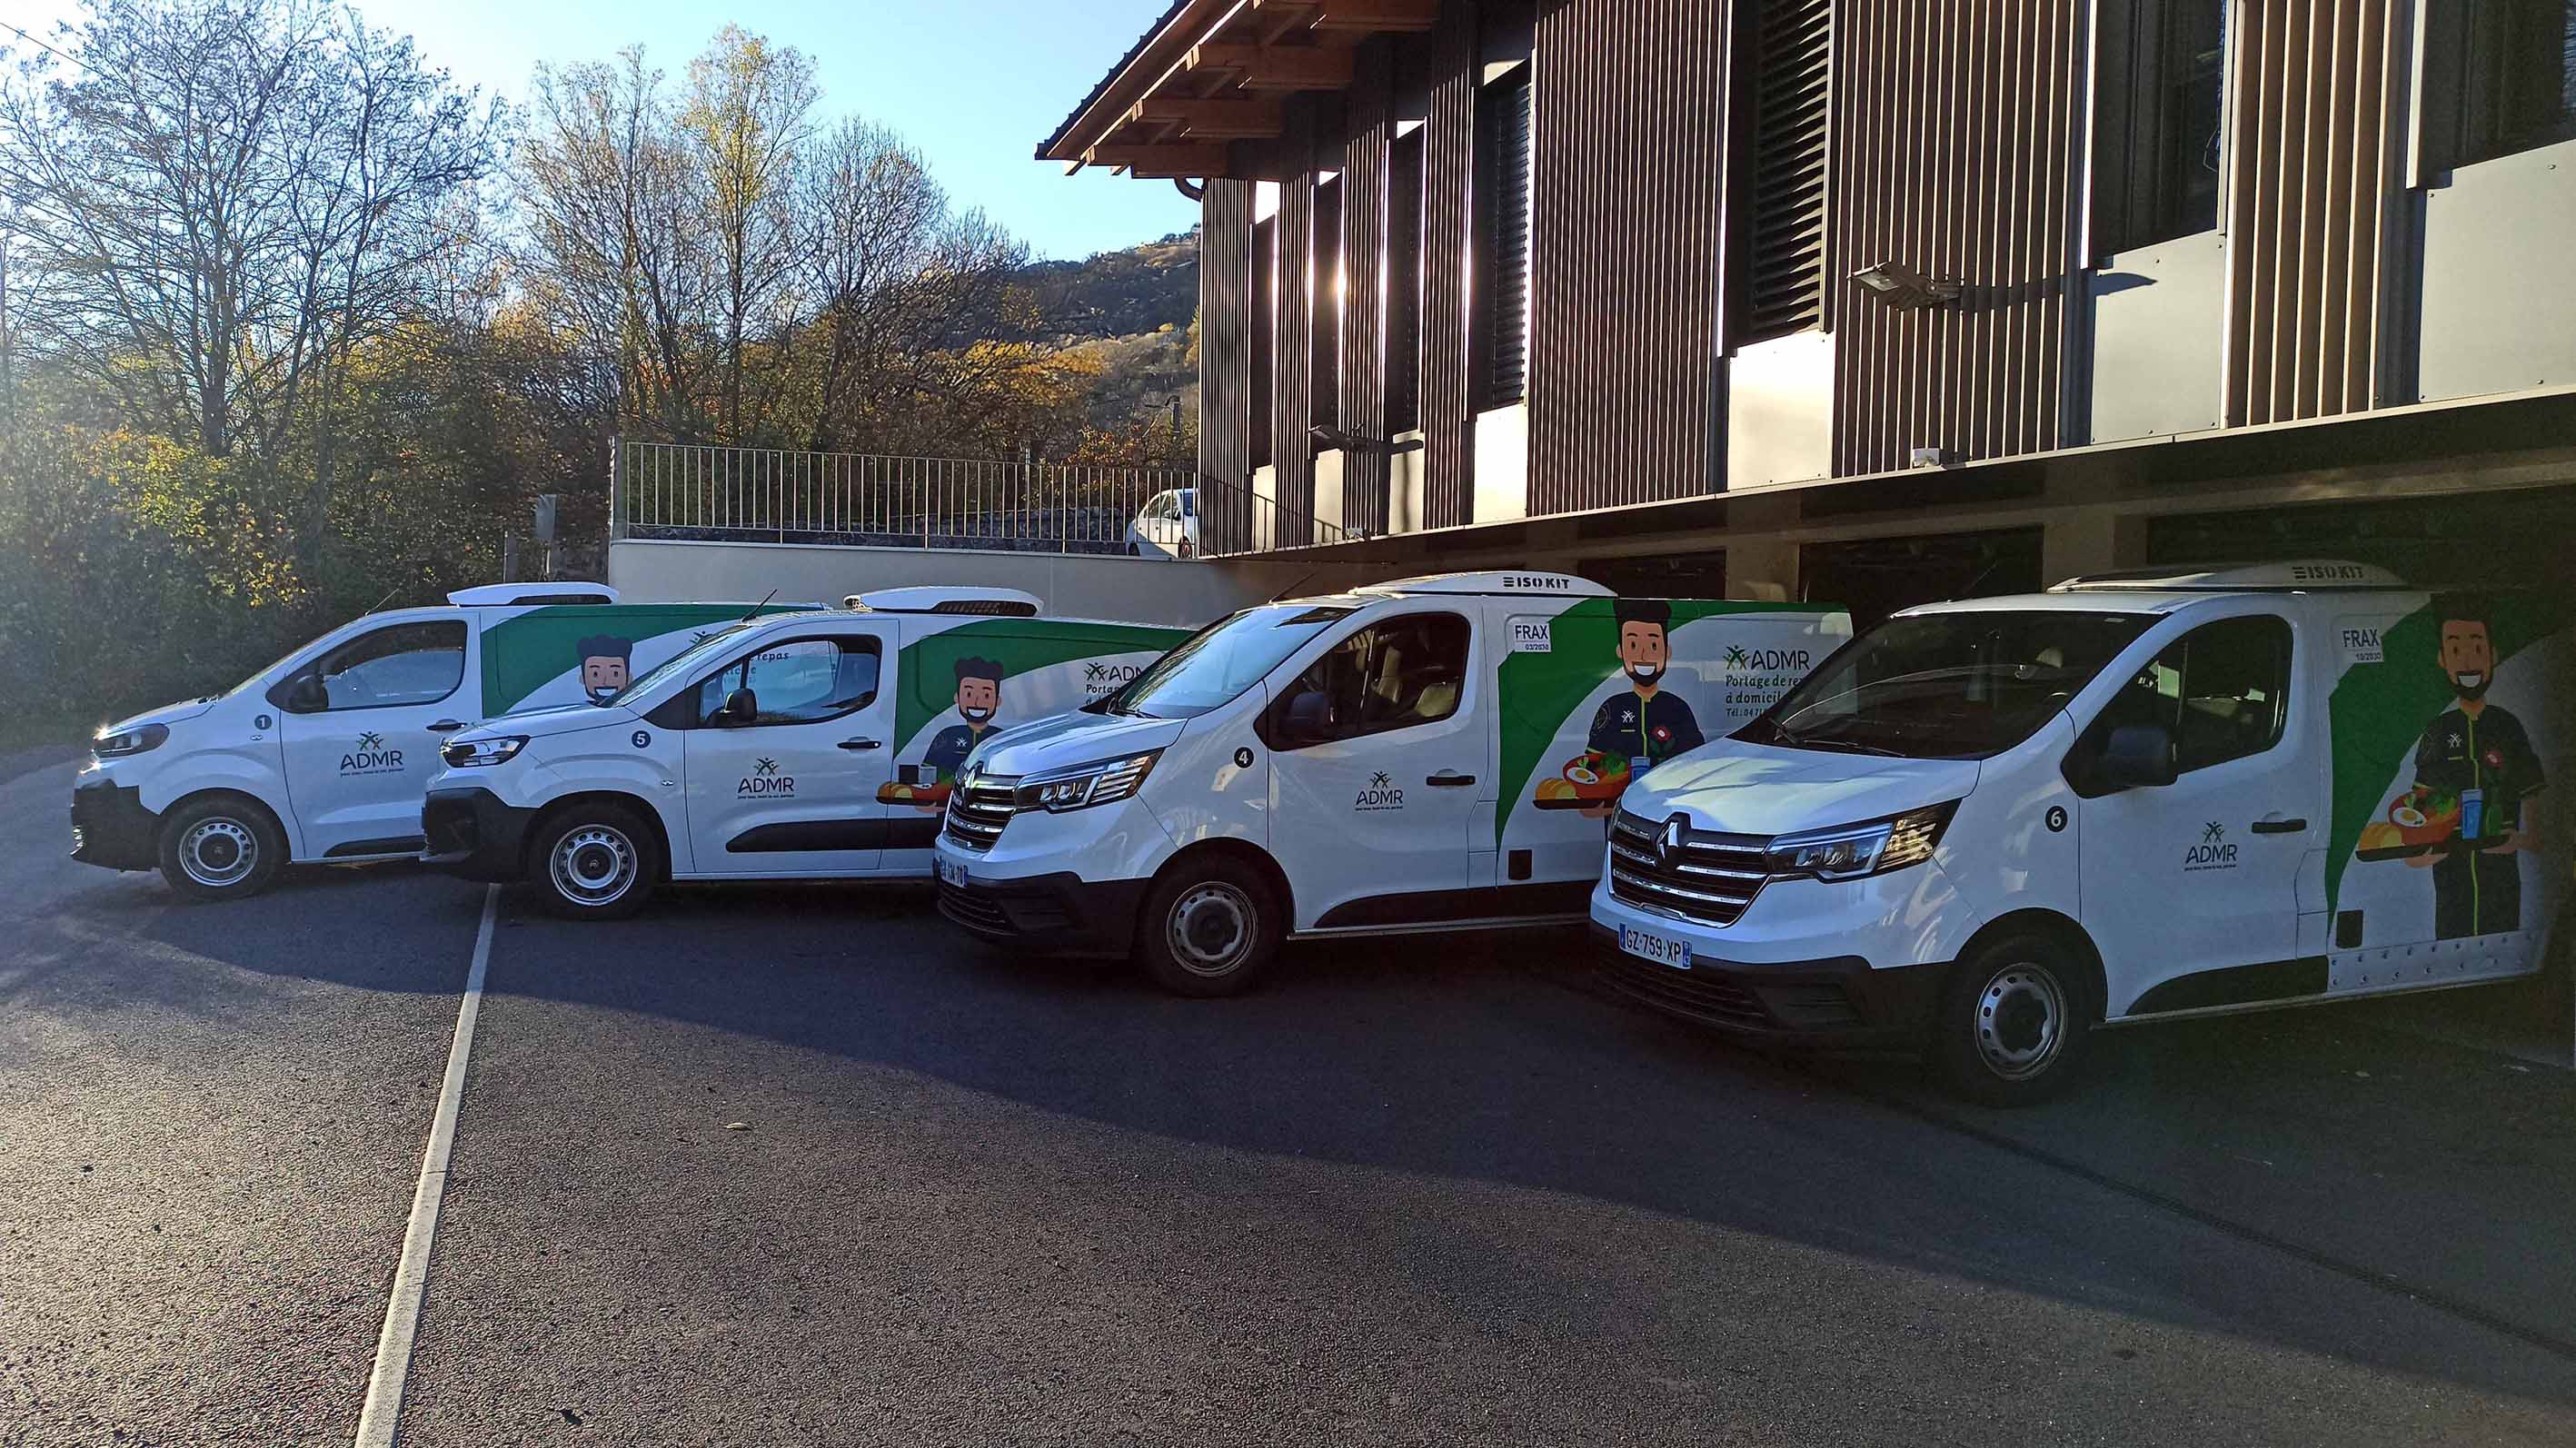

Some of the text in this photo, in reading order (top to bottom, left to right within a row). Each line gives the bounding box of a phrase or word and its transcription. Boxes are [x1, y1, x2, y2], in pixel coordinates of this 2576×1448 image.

[1514, 624, 1549, 640] FRAX
[2342, 629, 2380, 648] FRAX
[1750, 650, 1810, 670] ADMR
[1109, 665, 1143, 682] AD
[1726, 674, 1770, 689] Portage
[1772, 674, 1786, 687] de
[1086, 683, 1120, 694] Porta
[1736, 690, 1782, 704] domicil
[259, 717, 266, 728] 1
[636, 733, 646, 745] 5
[340, 750, 403, 771] ADMR
[1238, 750, 1249, 765] 4
[737, 777, 795, 794] ADMR
[1355, 789, 1405, 807] ADMR
[2050, 810, 2063, 828] 6
[2185, 843, 2238, 865] ADMR
